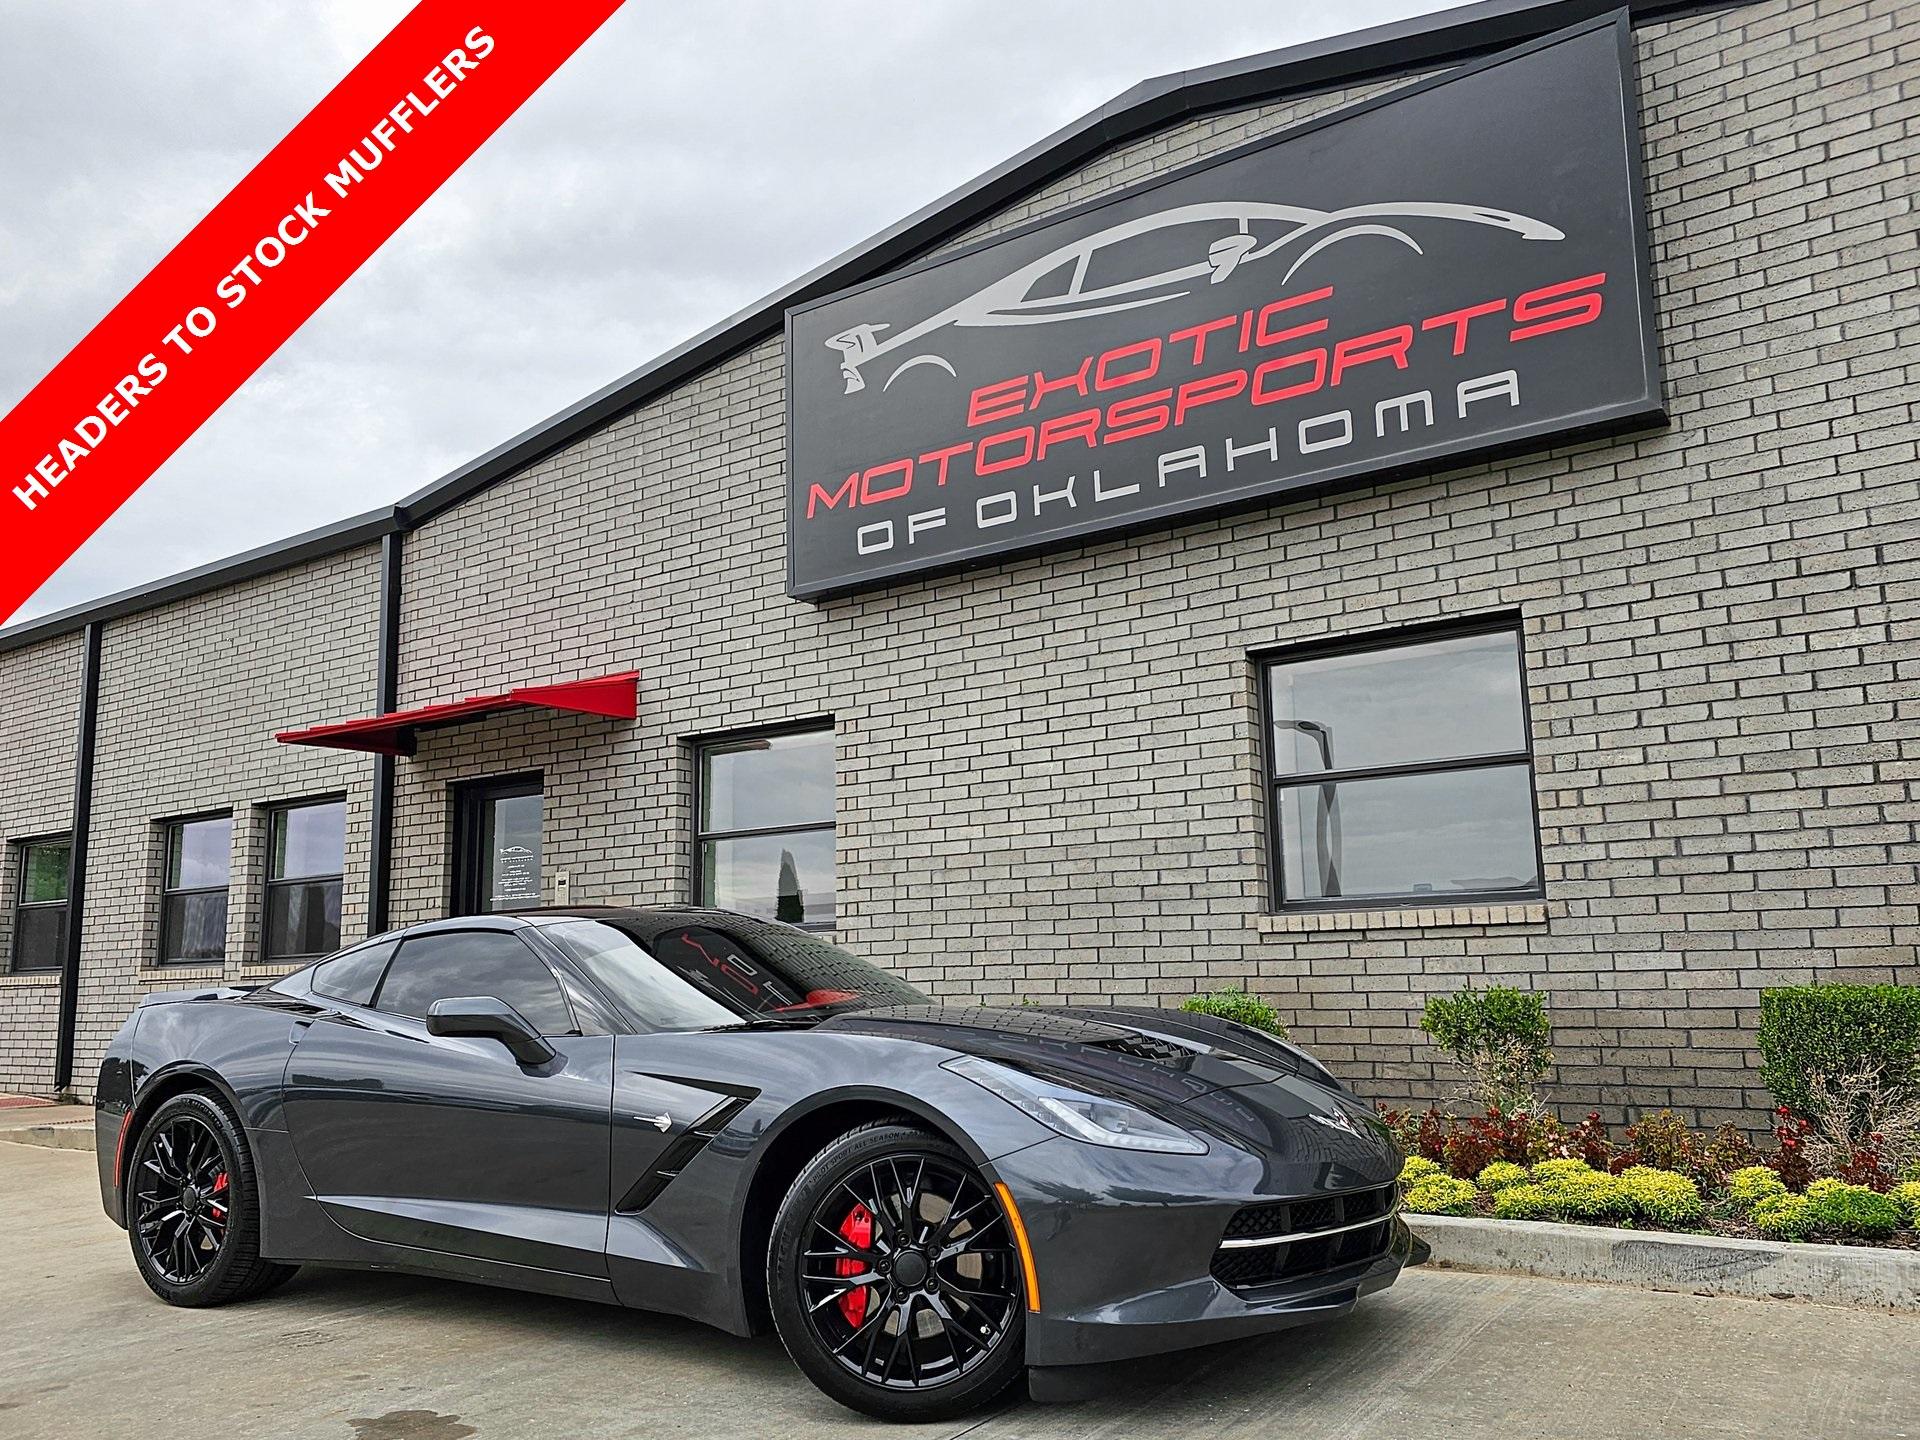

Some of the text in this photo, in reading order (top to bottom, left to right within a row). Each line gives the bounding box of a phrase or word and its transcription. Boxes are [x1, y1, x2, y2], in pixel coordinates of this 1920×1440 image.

[806, 272, 1606, 518] MOTORSPORTS
[967, 286, 1334, 427] EXOTIC
[856, 369, 1520, 556] OF OKLAHOMA
[869, 1132, 900, 1142] SEASON
